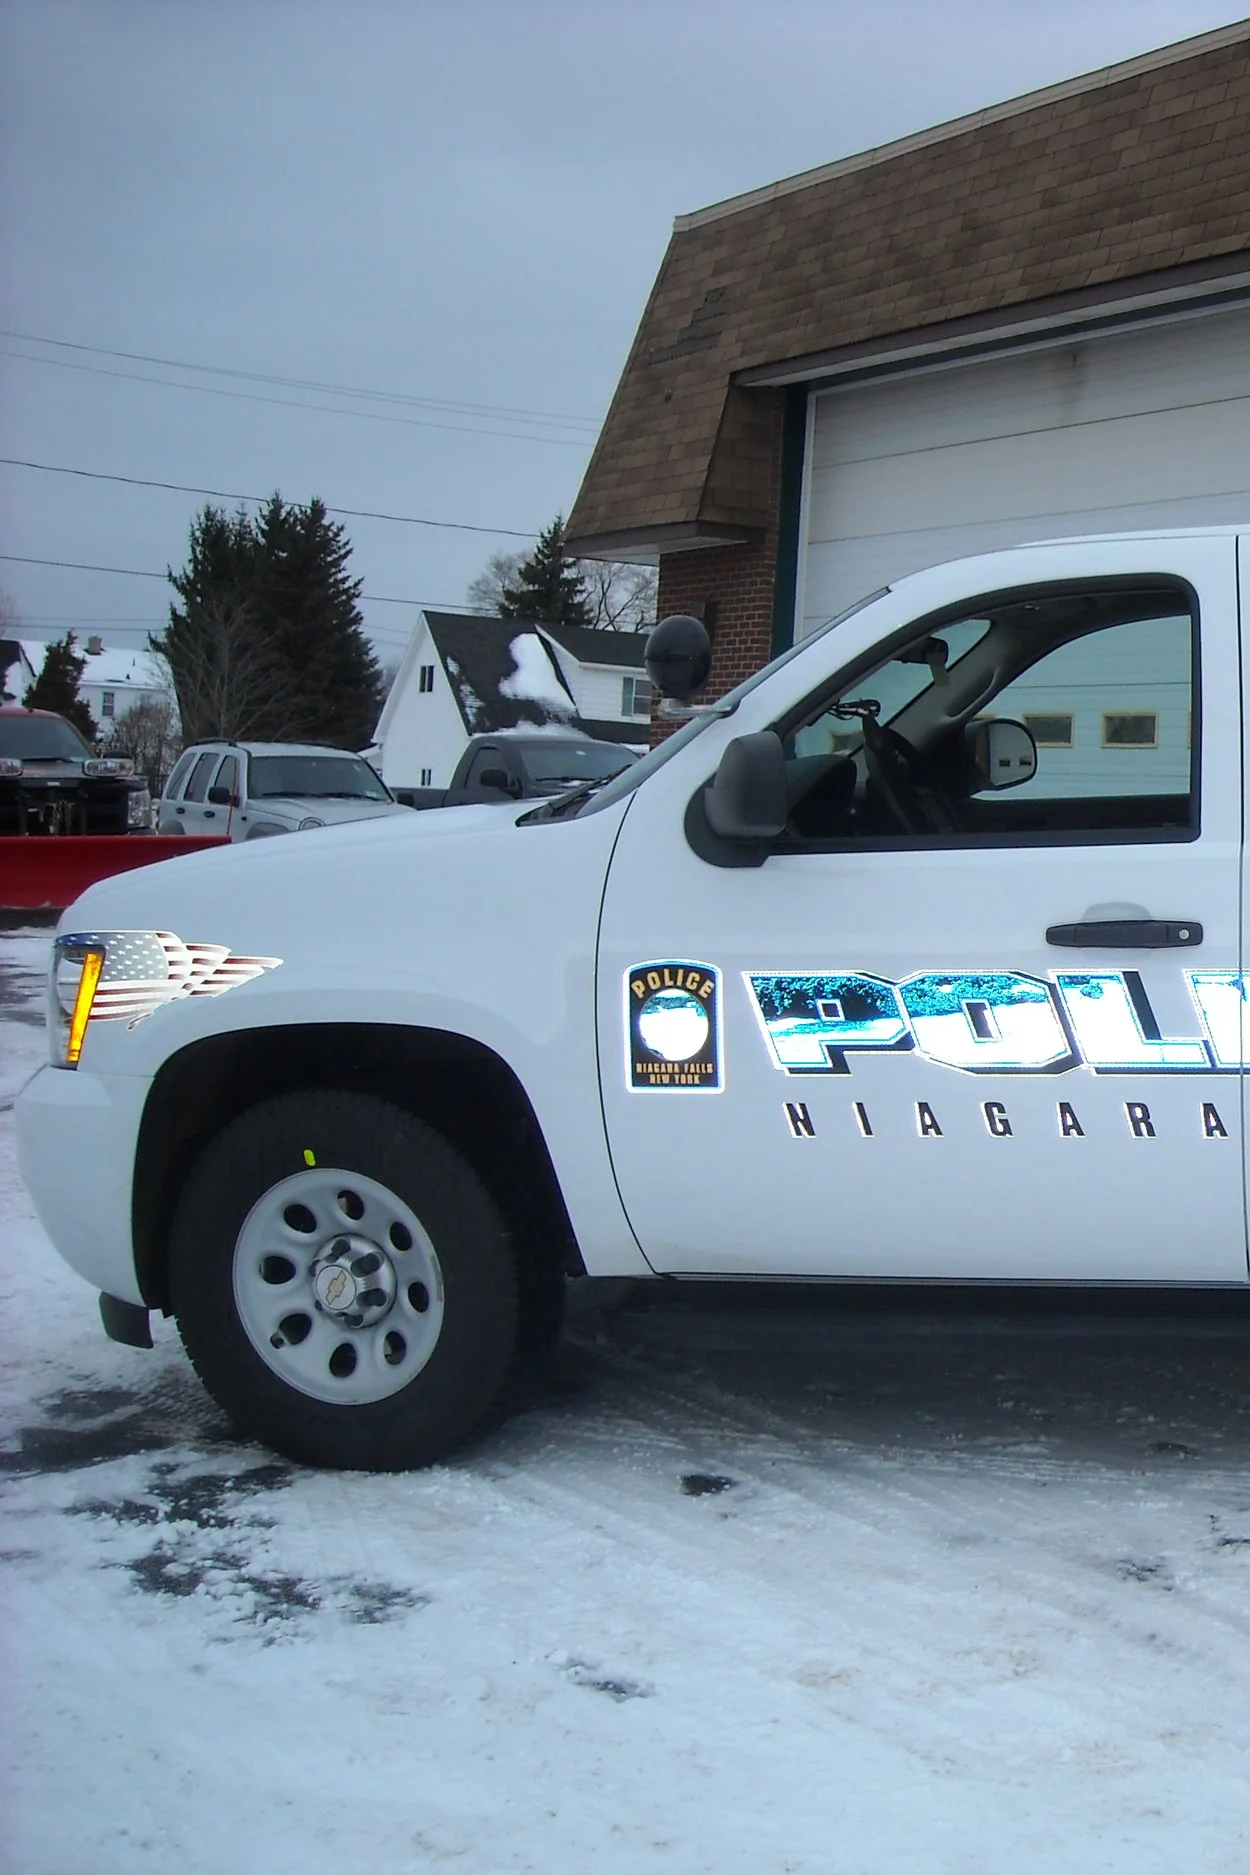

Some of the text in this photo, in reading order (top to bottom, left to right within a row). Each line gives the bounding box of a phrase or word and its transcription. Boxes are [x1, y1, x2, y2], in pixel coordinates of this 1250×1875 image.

[631, 968, 715, 999] POLICE
[636, 1063, 713, 1074] NIAGARA FALLS
[650, 1074, 700, 1085] NEW YORK
[782, 1101, 1228, 1138] NIAGARA
